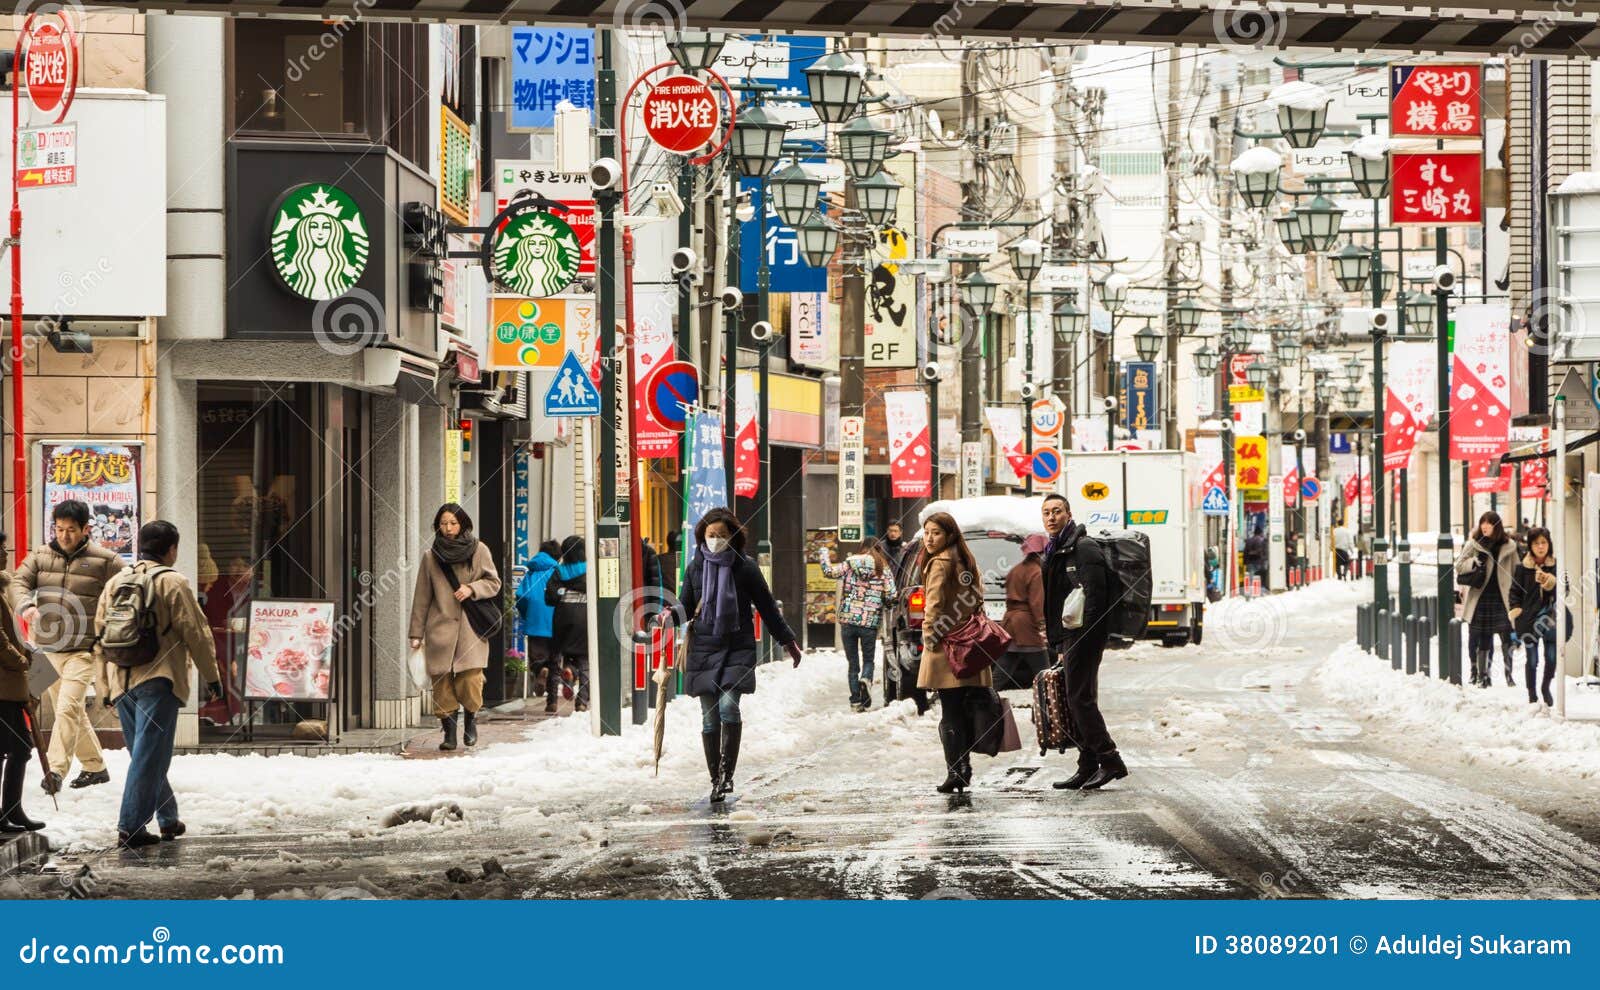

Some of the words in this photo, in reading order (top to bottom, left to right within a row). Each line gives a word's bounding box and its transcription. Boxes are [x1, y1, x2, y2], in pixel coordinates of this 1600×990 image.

[513, 31, 595, 65] マンショ
[29, 51, 65, 85] 消火栓
[1394, 68, 1402, 84] 1
[654, 86, 671, 95] FIRE
[672, 85, 705, 95] HYDRANT
[1412, 70, 1471, 97] やきとり
[650, 98, 713, 129] 消火栓
[1419, 158, 1454, 185] すし
[1403, 188, 1472, 219] 三崎丸
[498, 323, 560, 342] 健康堂
[871, 343, 900, 361] 2F
[1090, 512, 1120, 525] クール
[255, 608, 299, 617] SAKURA
